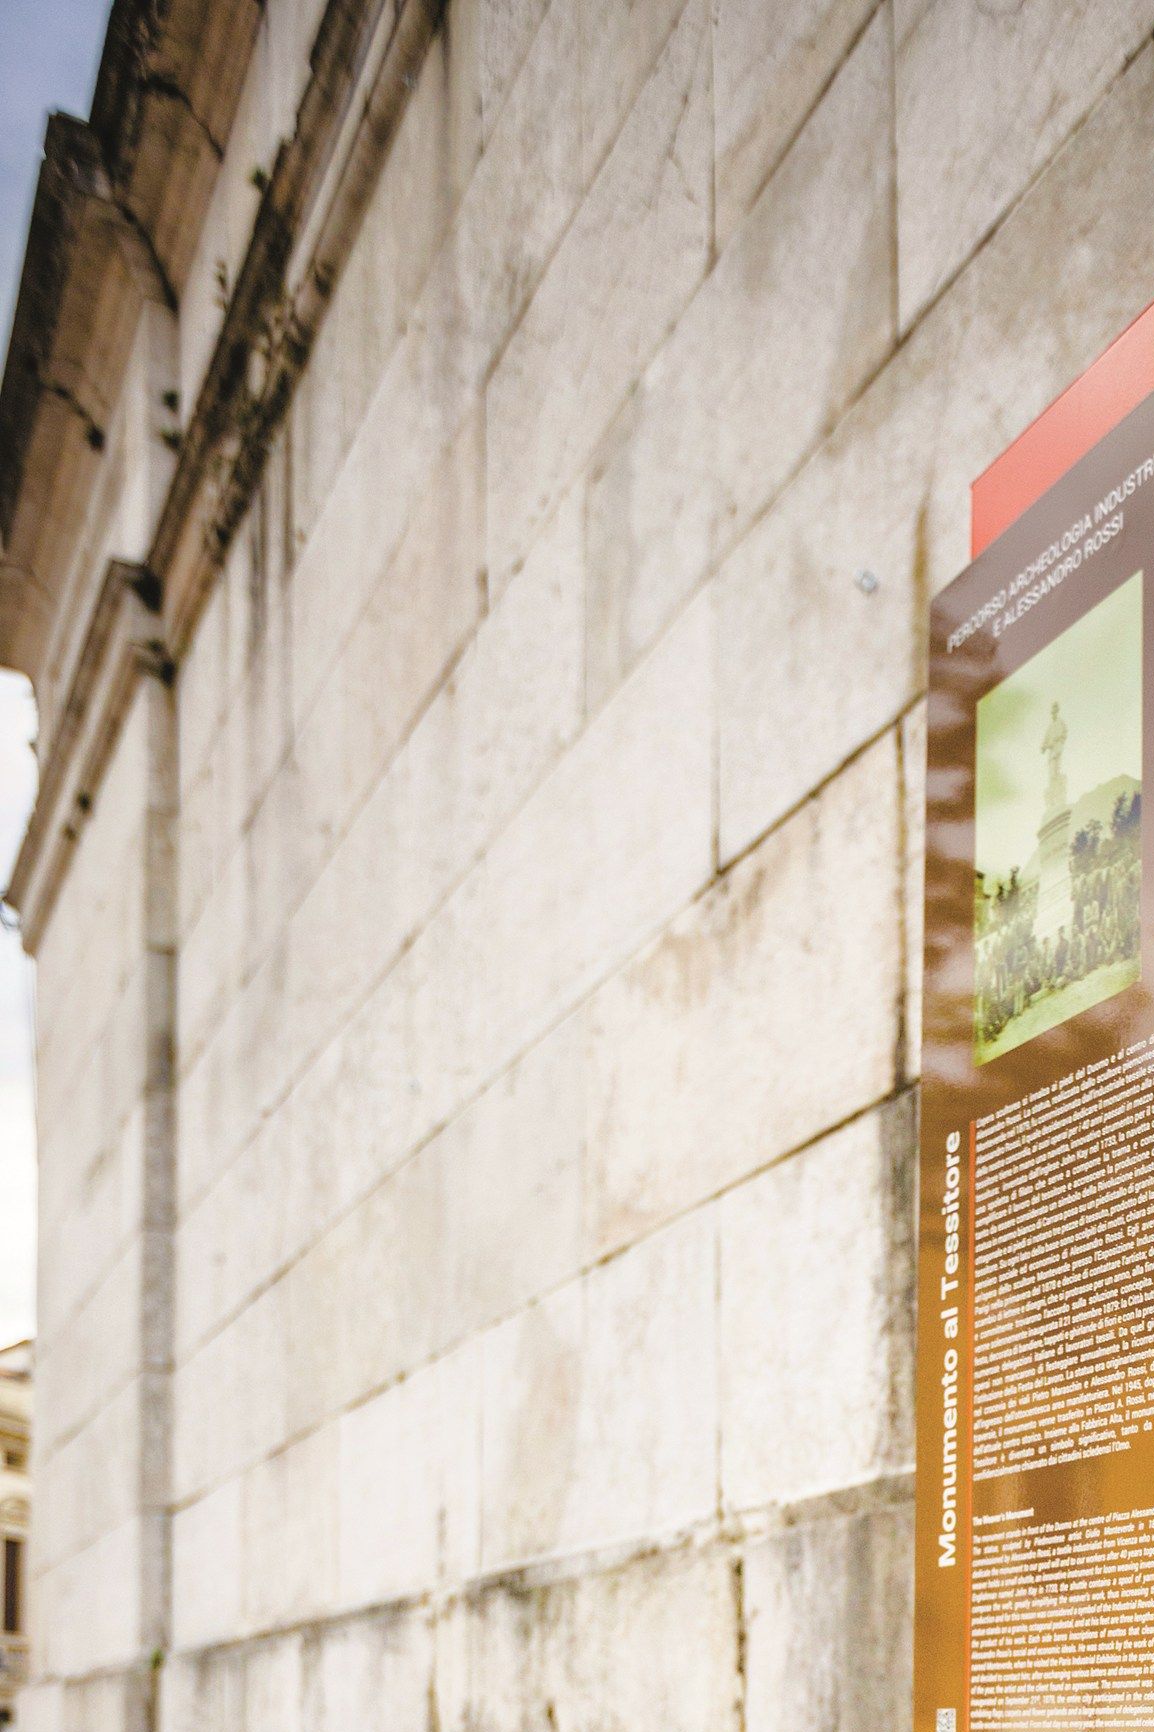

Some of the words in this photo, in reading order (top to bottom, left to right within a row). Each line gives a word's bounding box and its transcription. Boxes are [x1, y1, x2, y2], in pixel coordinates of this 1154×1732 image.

[947, 588, 1007, 654] PERCORSO
[1007, 513, 1093, 600] ARCHEOLOGIA
[992, 617, 1004, 638] E
[1003, 547, 1082, 629] ALESSANDRO
[1083, 512, 1124, 561] ROSSI
[941, 1130, 960, 1301] Tessitore
[940, 1306, 959, 1339] al
[938, 1348, 958, 1568] Monumento
